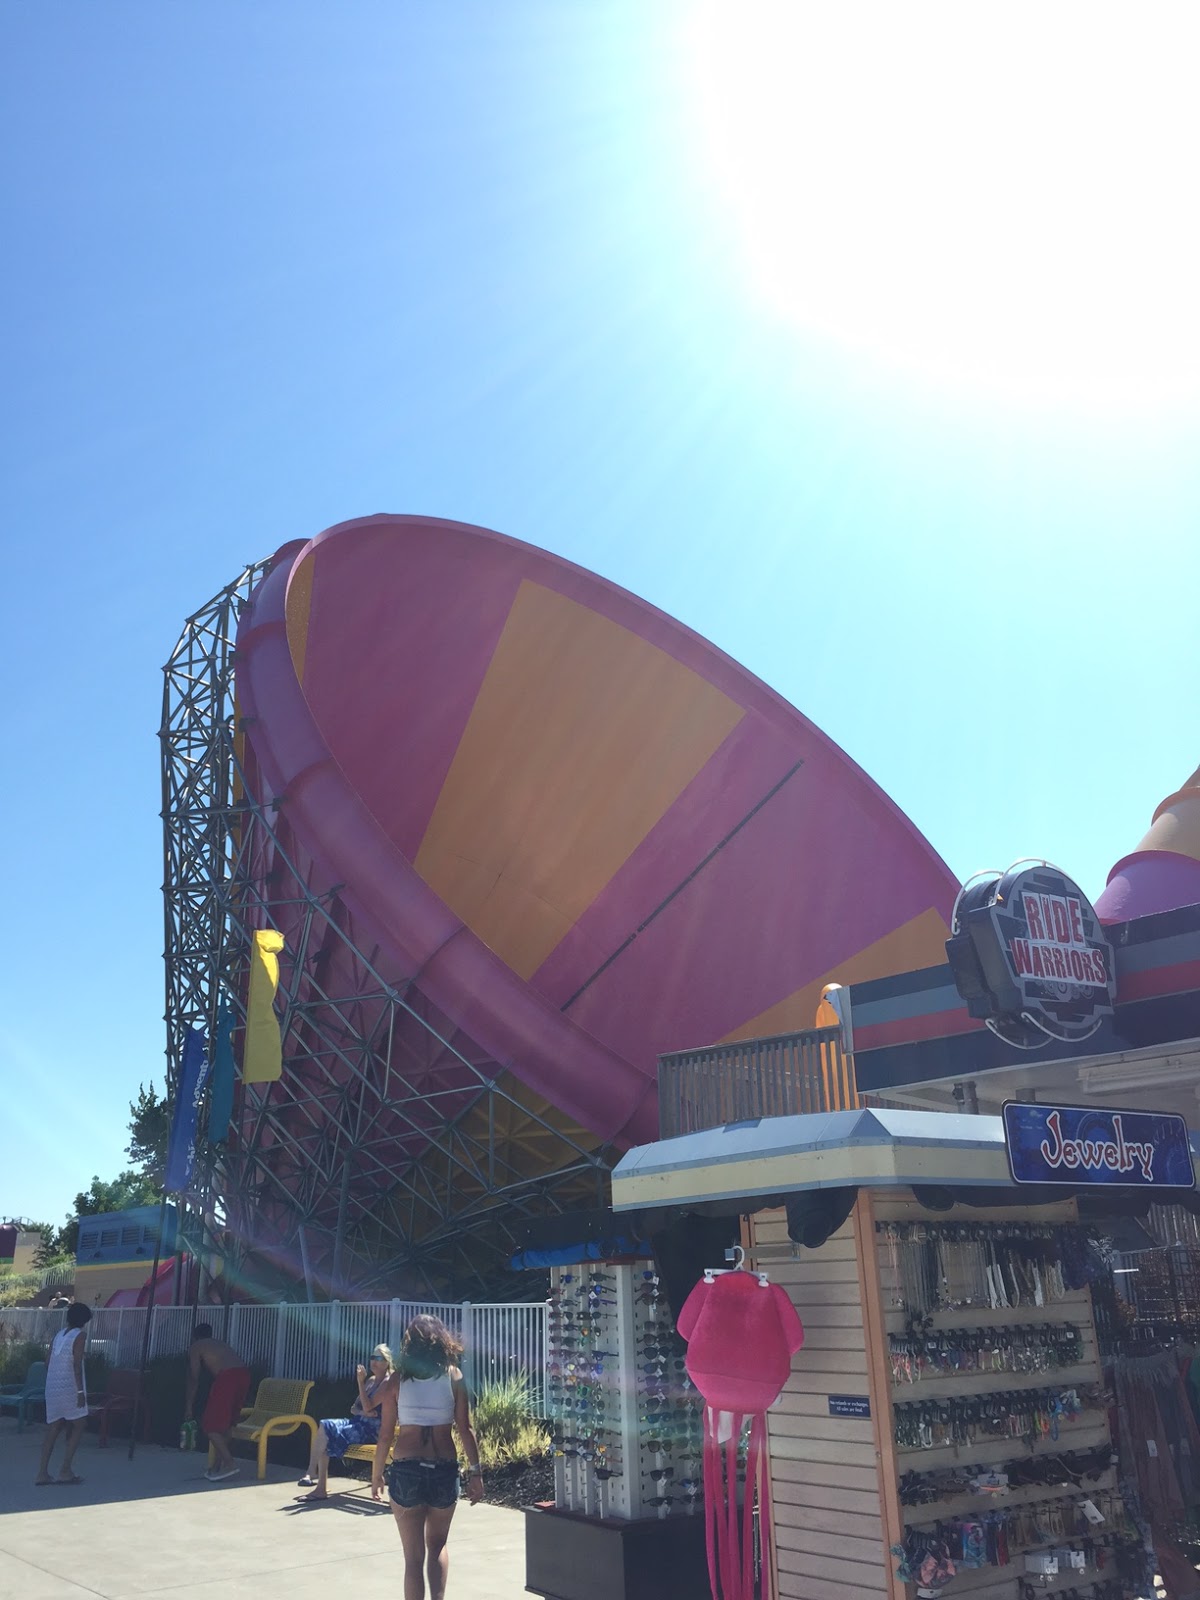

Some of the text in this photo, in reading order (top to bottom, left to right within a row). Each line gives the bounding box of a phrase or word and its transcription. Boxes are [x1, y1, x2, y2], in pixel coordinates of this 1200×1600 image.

[1023, 895, 1084, 944] RIDE
[1008, 938, 1107, 985] WARRIORS
[1040, 1110, 1154, 1182] Jewelry
